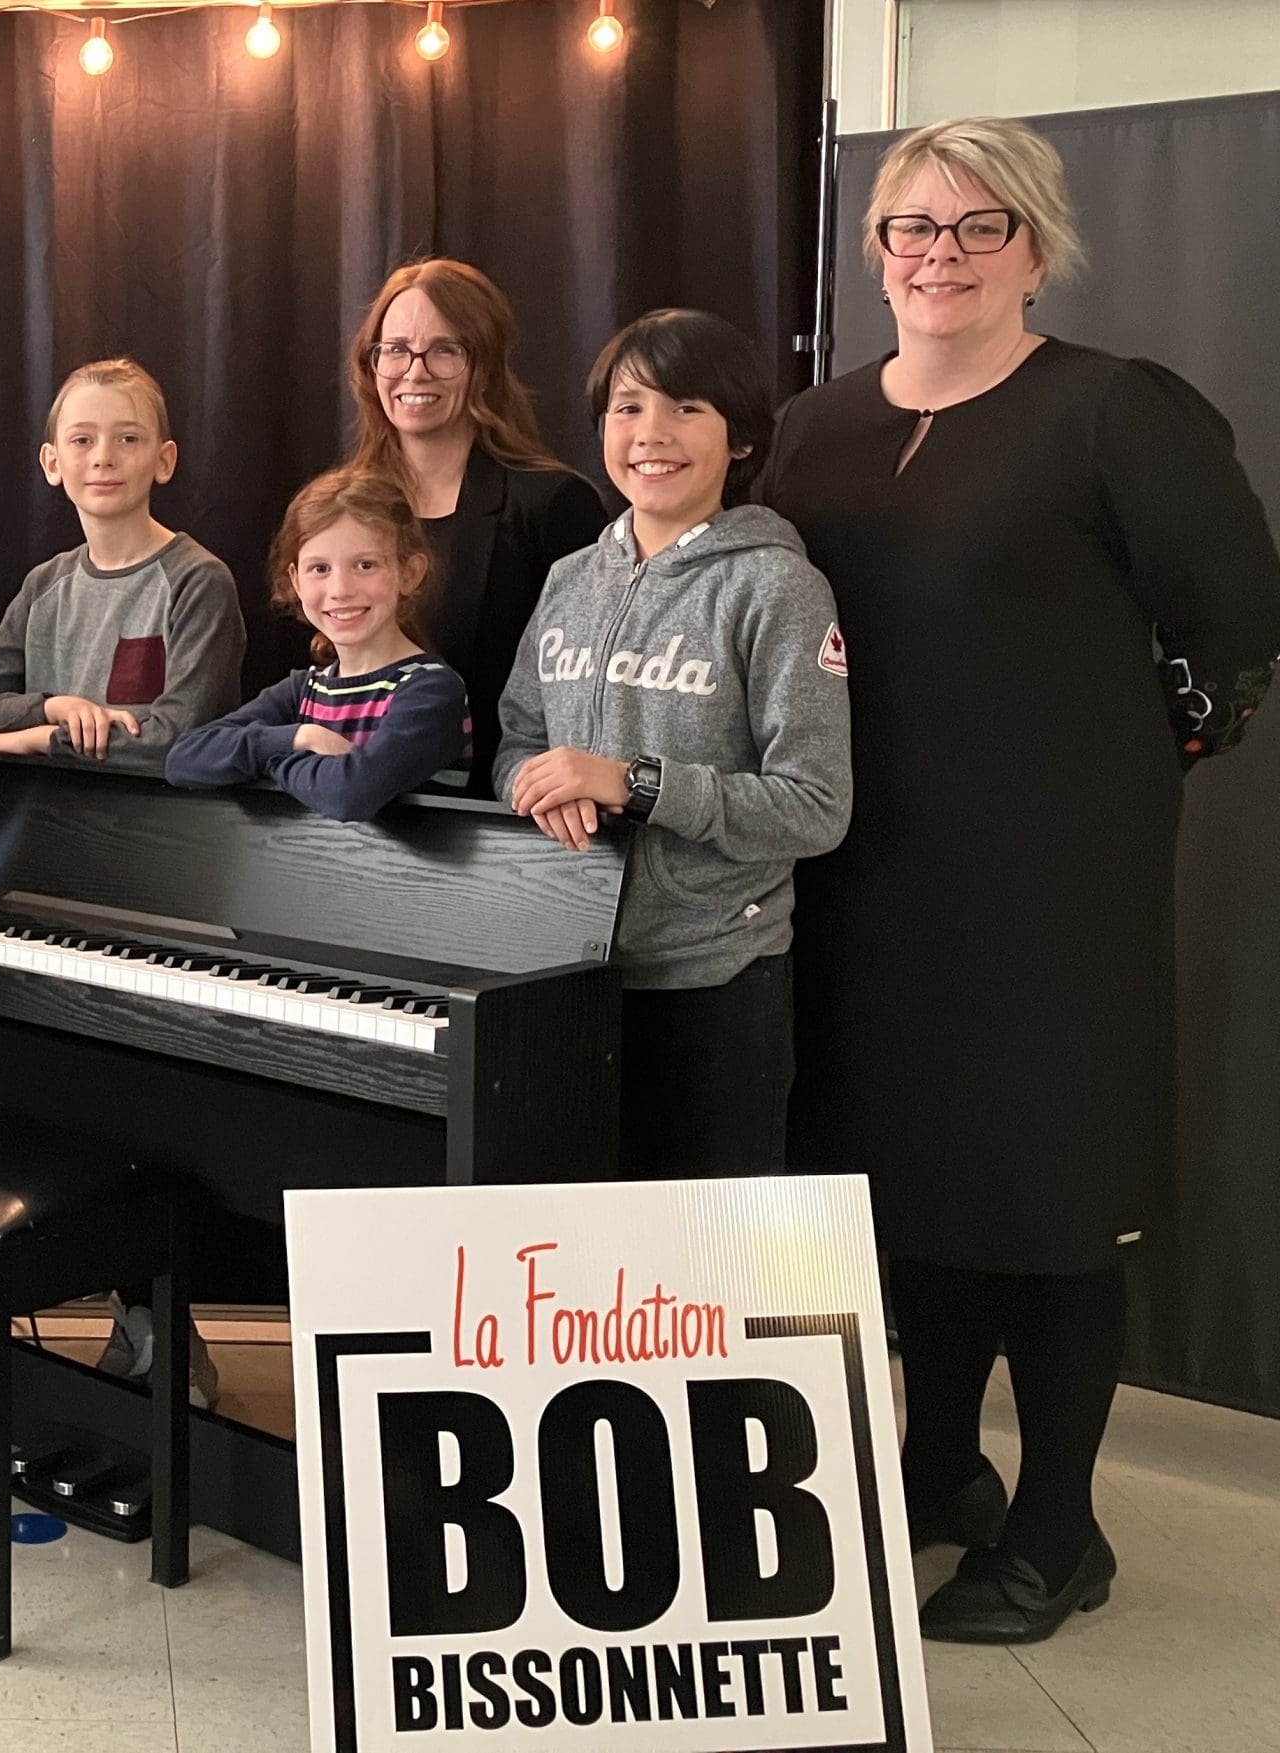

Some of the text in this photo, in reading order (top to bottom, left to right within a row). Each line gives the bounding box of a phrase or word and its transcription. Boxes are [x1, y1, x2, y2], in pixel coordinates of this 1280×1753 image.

[538, 628, 717, 695] Canada
[452, 1242, 730, 1368] La Fondation
[376, 1377, 837, 1638] BOB
[391, 1634, 849, 1733] BISSONNETTE
